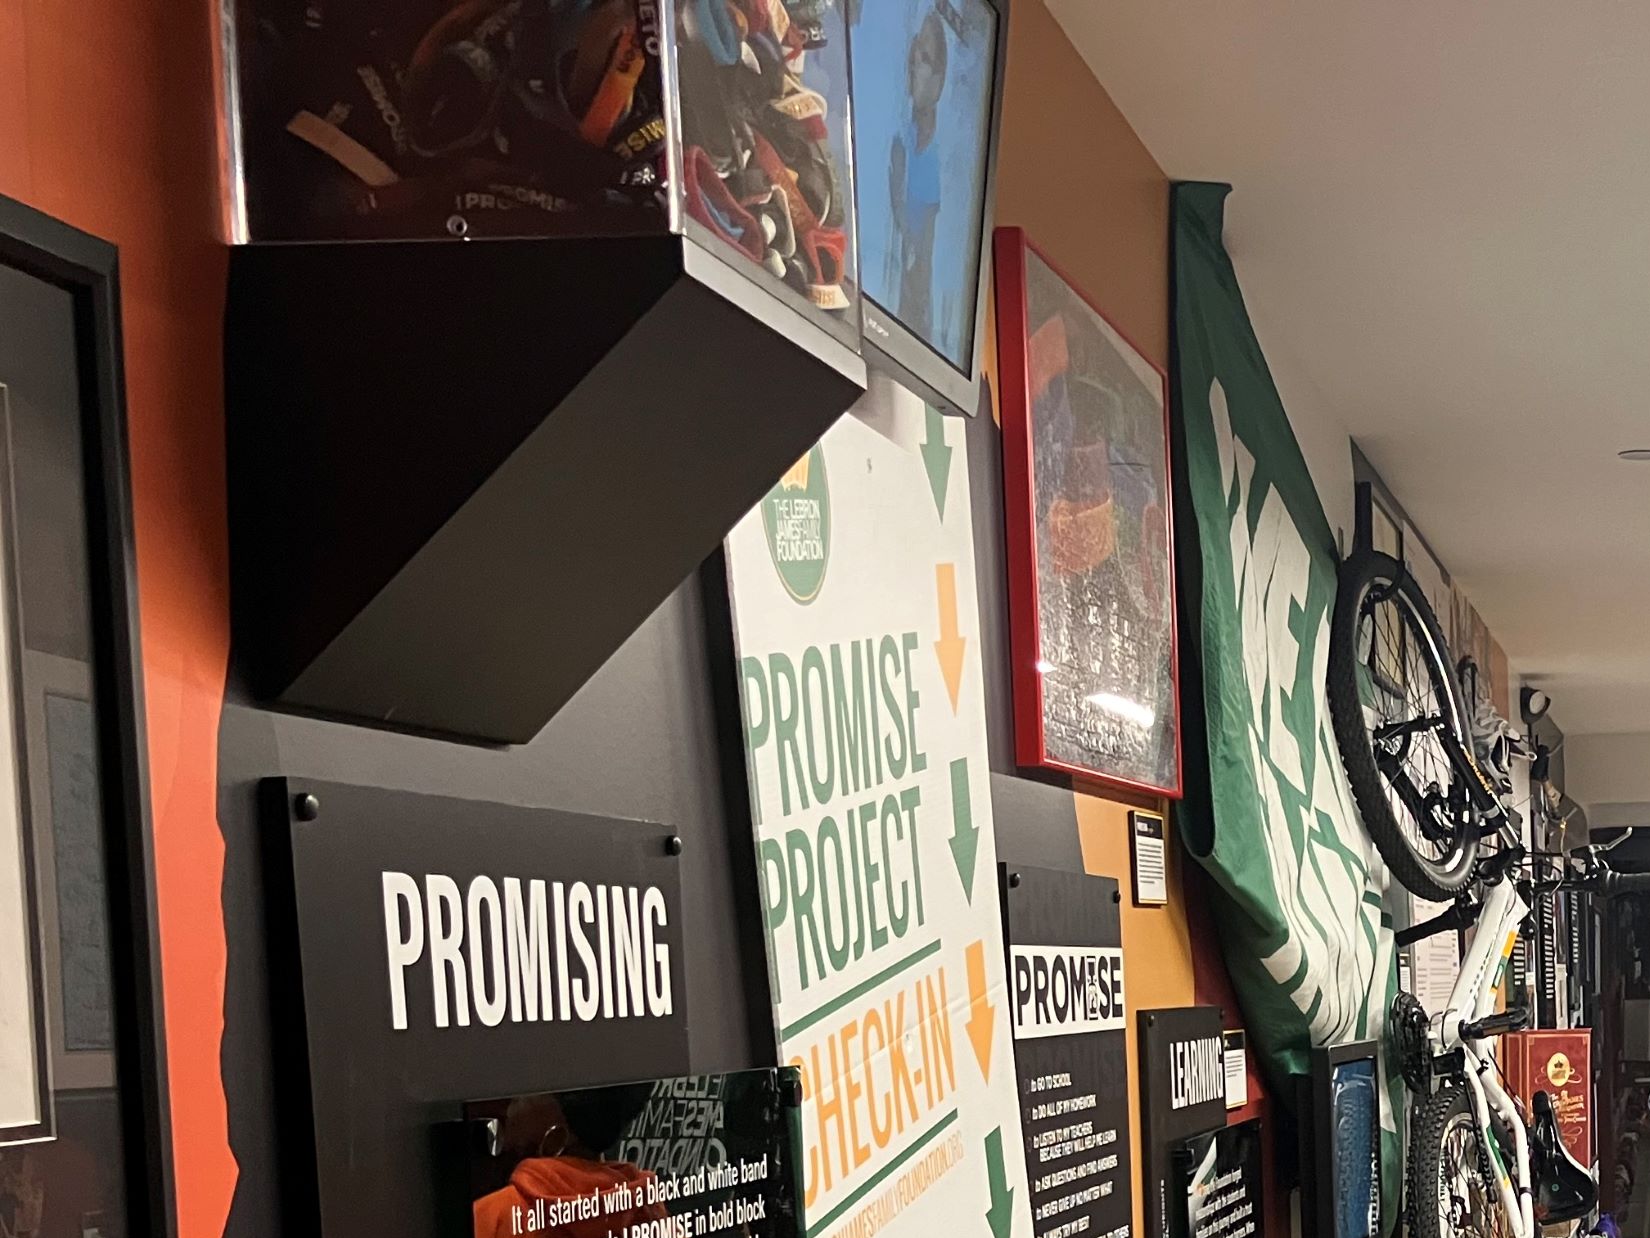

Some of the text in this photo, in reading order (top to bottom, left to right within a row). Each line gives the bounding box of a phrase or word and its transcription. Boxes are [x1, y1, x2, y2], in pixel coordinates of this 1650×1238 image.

[742, 631, 928, 826] PROMISE
[382, 870, 674, 1031] PROMISING
[760, 784, 928, 1005] PROJECT
[789, 966, 959, 1211] CHECK-IN
[1169, 1035, 1225, 1110] LEARNING
[511, 1153, 768, 1236] It all started with a black and white band
[694, 1208, 707, 1236] in
[708, 1200, 734, 1232] bold
[736, 1193, 766, 1225] block
